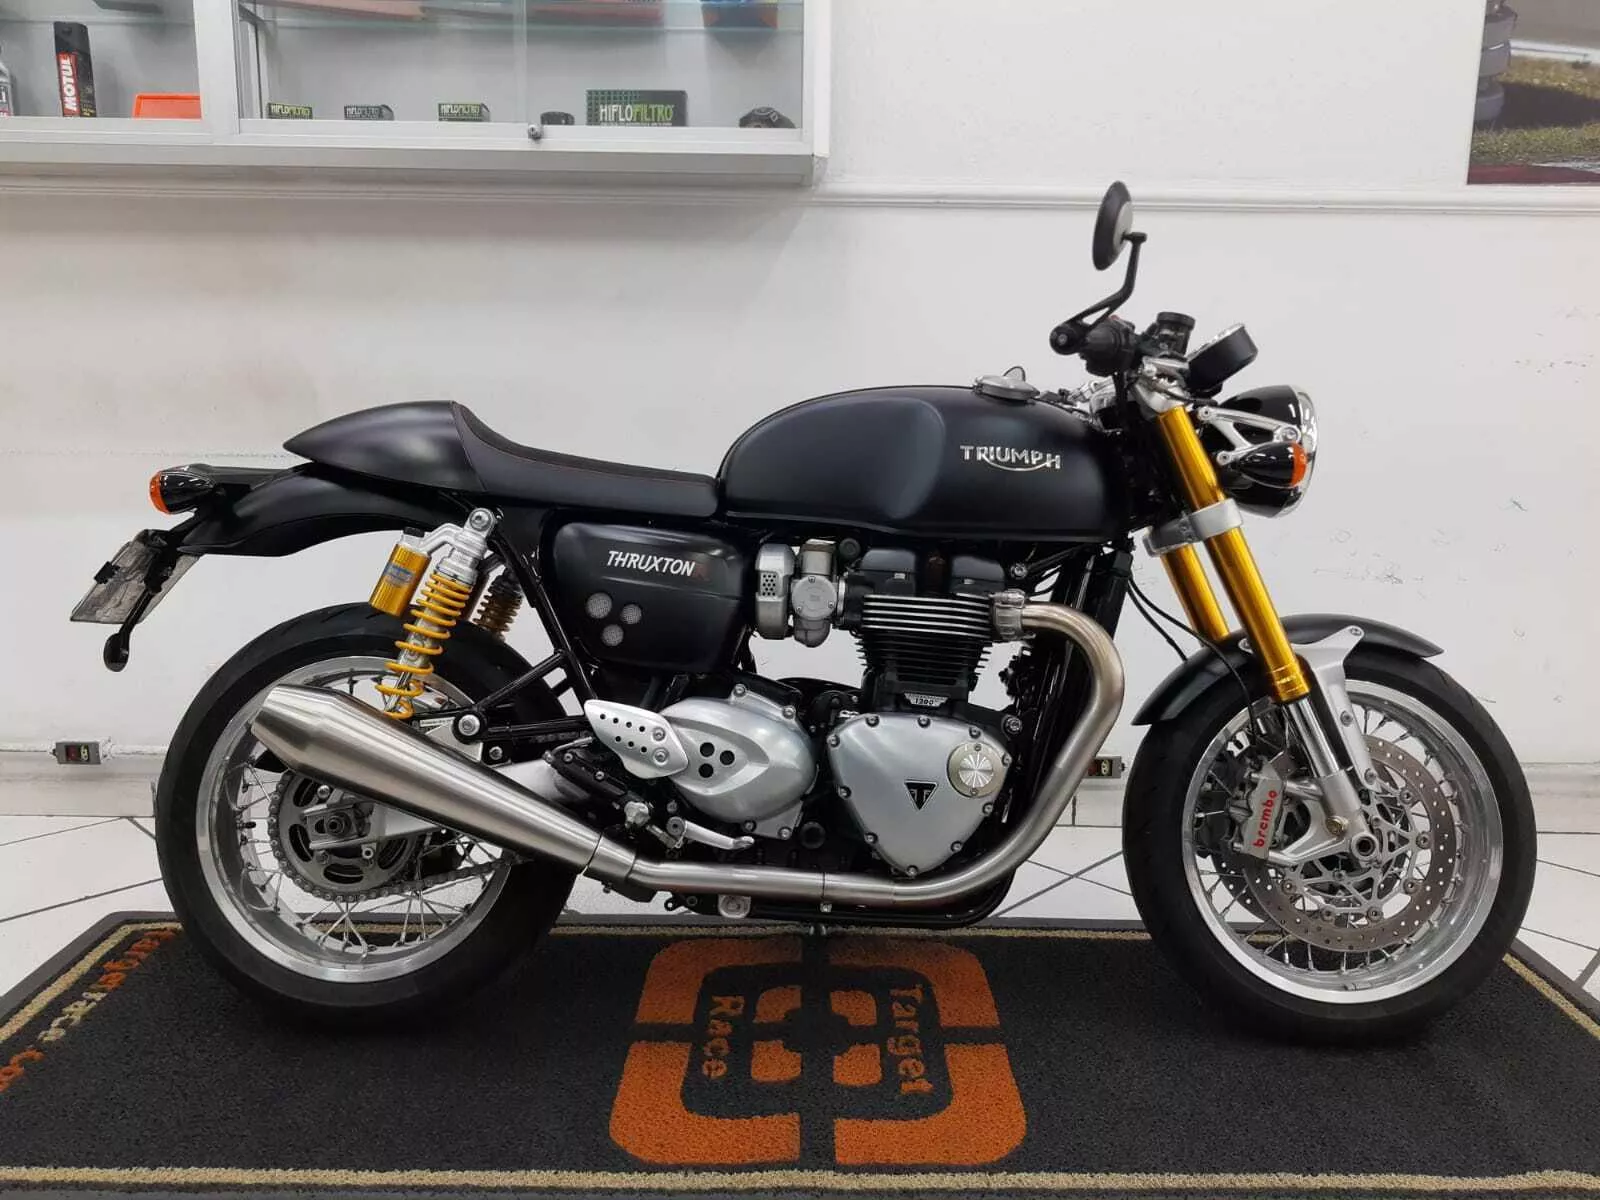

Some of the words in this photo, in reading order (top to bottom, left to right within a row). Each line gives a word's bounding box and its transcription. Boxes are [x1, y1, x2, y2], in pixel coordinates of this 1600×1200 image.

[61, 56, 77, 111] MOTUL
[600, 103, 674, 121] HIFLOFILTRO
[960, 445, 1061, 470] TRIUMPH
[606, 550, 695, 576] THRUXTON
[1253, 790, 1277, 847] brembo
[702, 995, 745, 1079] Race
[889, 984, 933, 1096] Target
